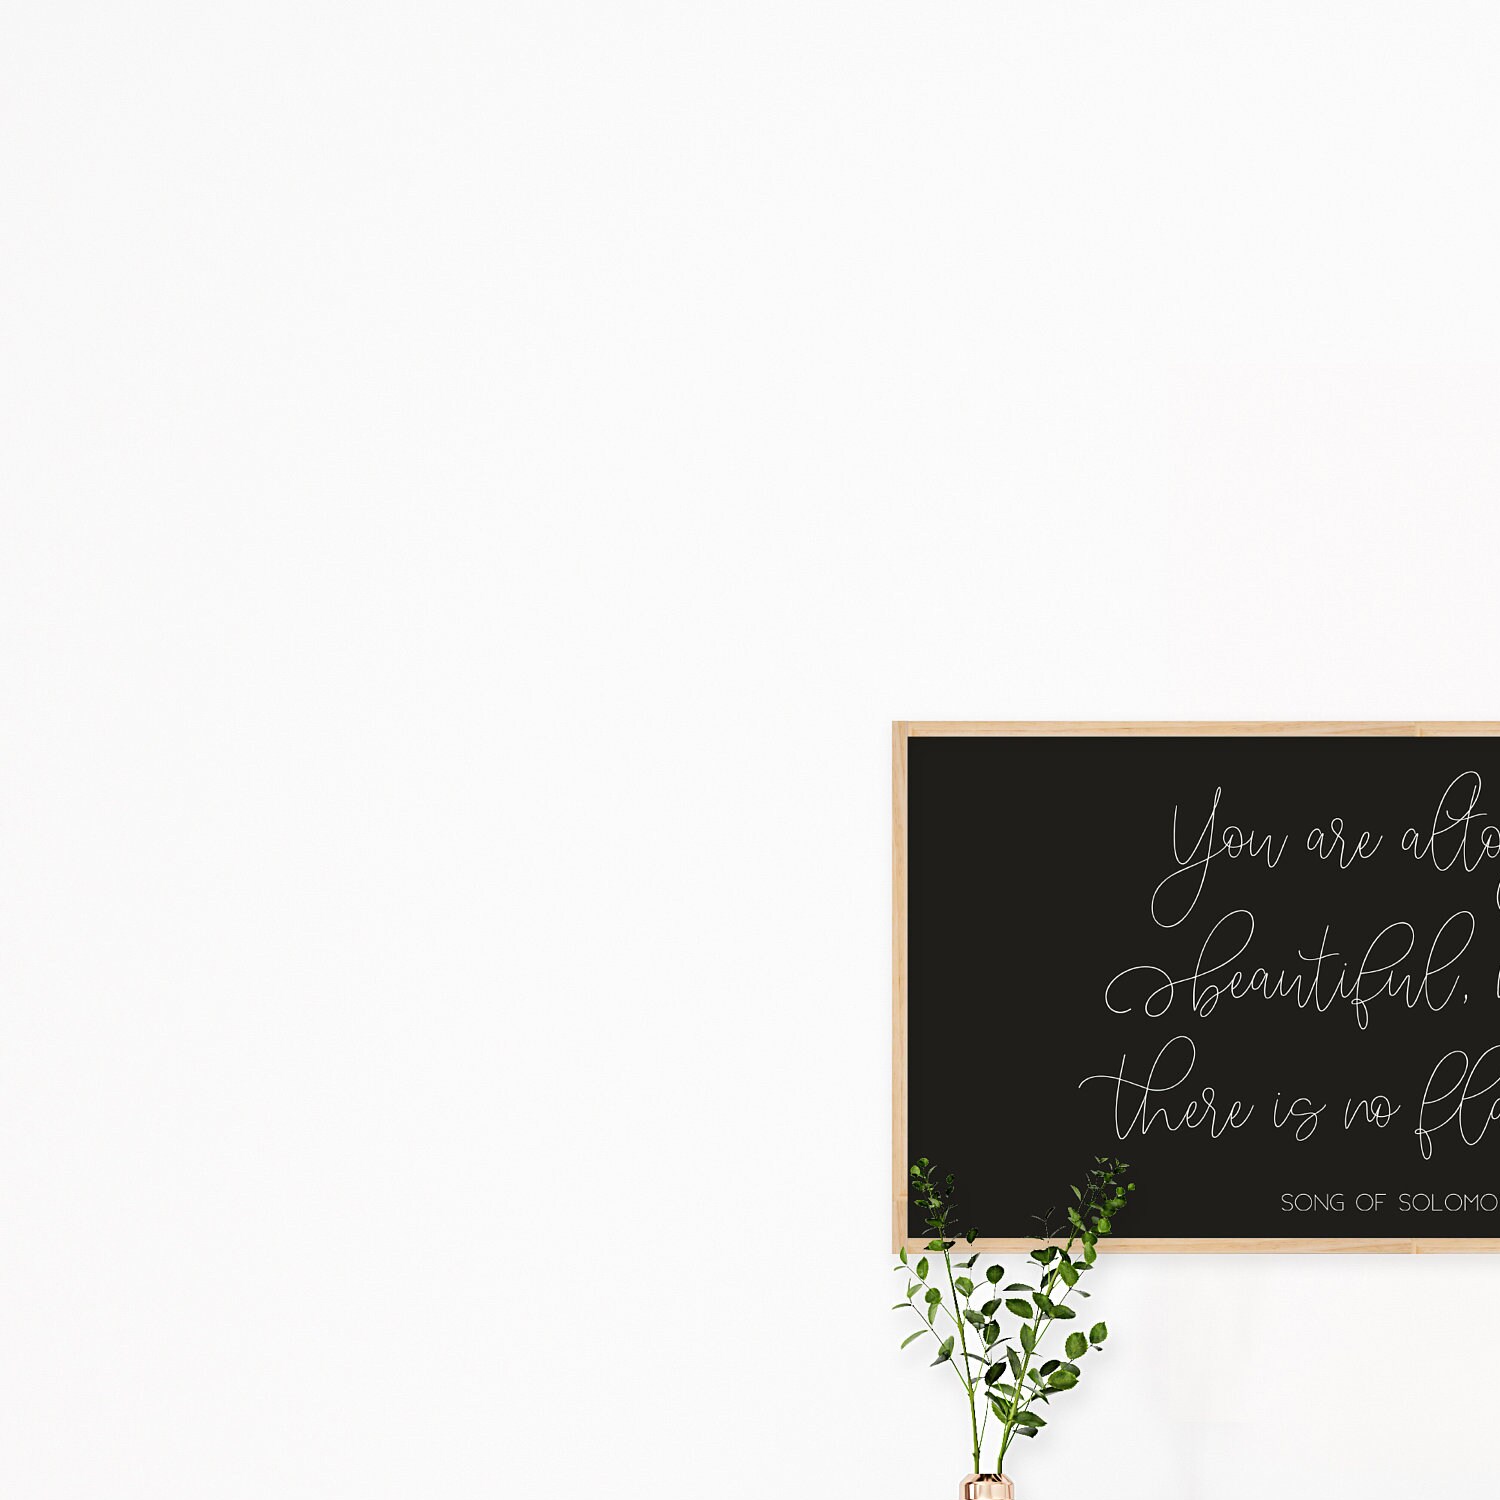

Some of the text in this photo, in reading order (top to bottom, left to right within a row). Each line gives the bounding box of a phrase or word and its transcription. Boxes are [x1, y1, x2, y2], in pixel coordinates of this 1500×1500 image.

[1151, 787, 1288, 928] You
[1306, 817, 1384, 870] are
[1104, 909, 1475, 1030] beautiful,
[1078, 1035, 1255, 1140] there
[1273, 1091, 1327, 1142] is
[1344, 1095, 1401, 1130] no
[1281, 1193, 1345, 1212] SONG
[1355, 1193, 1387, 1212] OF
